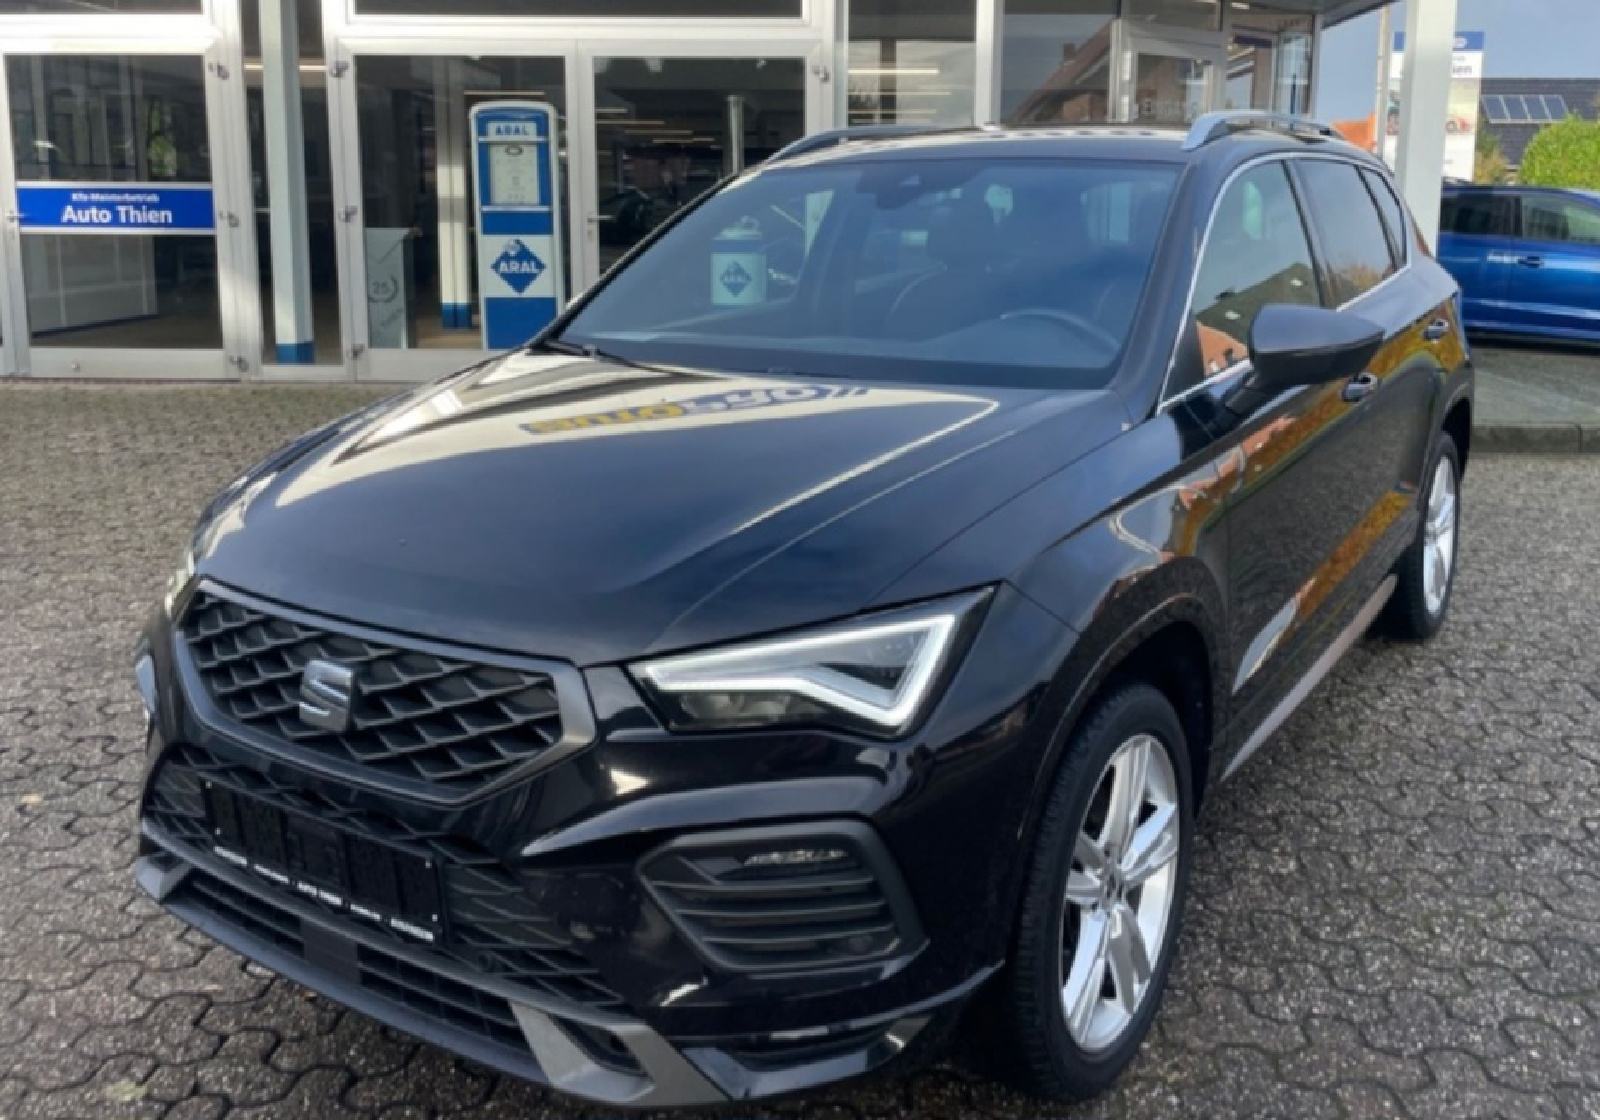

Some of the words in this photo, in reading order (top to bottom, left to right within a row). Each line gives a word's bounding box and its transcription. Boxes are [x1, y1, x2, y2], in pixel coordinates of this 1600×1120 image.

[495, 124, 530, 137] ARAL
[61, 204, 112, 224] Auto
[116, 204, 173, 224] Thien
[498, 260, 540, 274] ARAL
